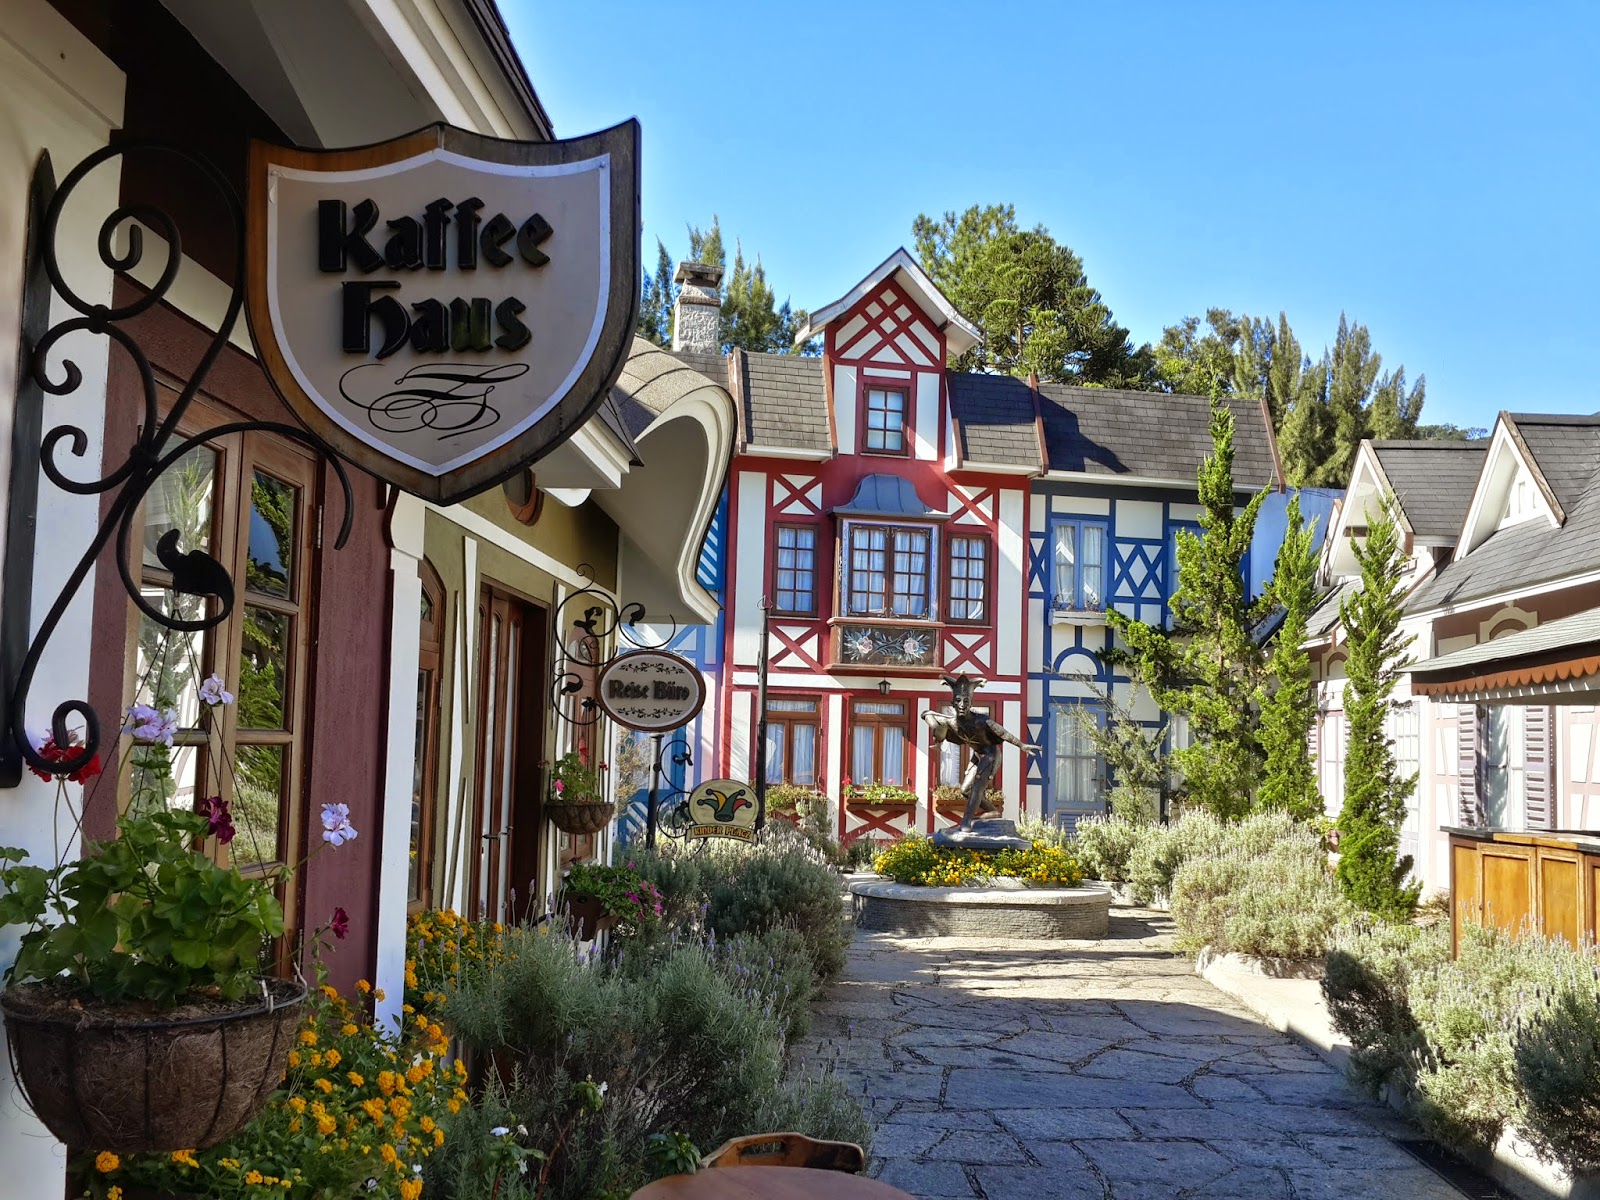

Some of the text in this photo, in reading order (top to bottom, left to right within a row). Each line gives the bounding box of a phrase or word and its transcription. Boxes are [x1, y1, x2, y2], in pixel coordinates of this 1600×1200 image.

[318, 197, 554, 272] Kaffee
[608, 679, 690, 700] Reise Büro
